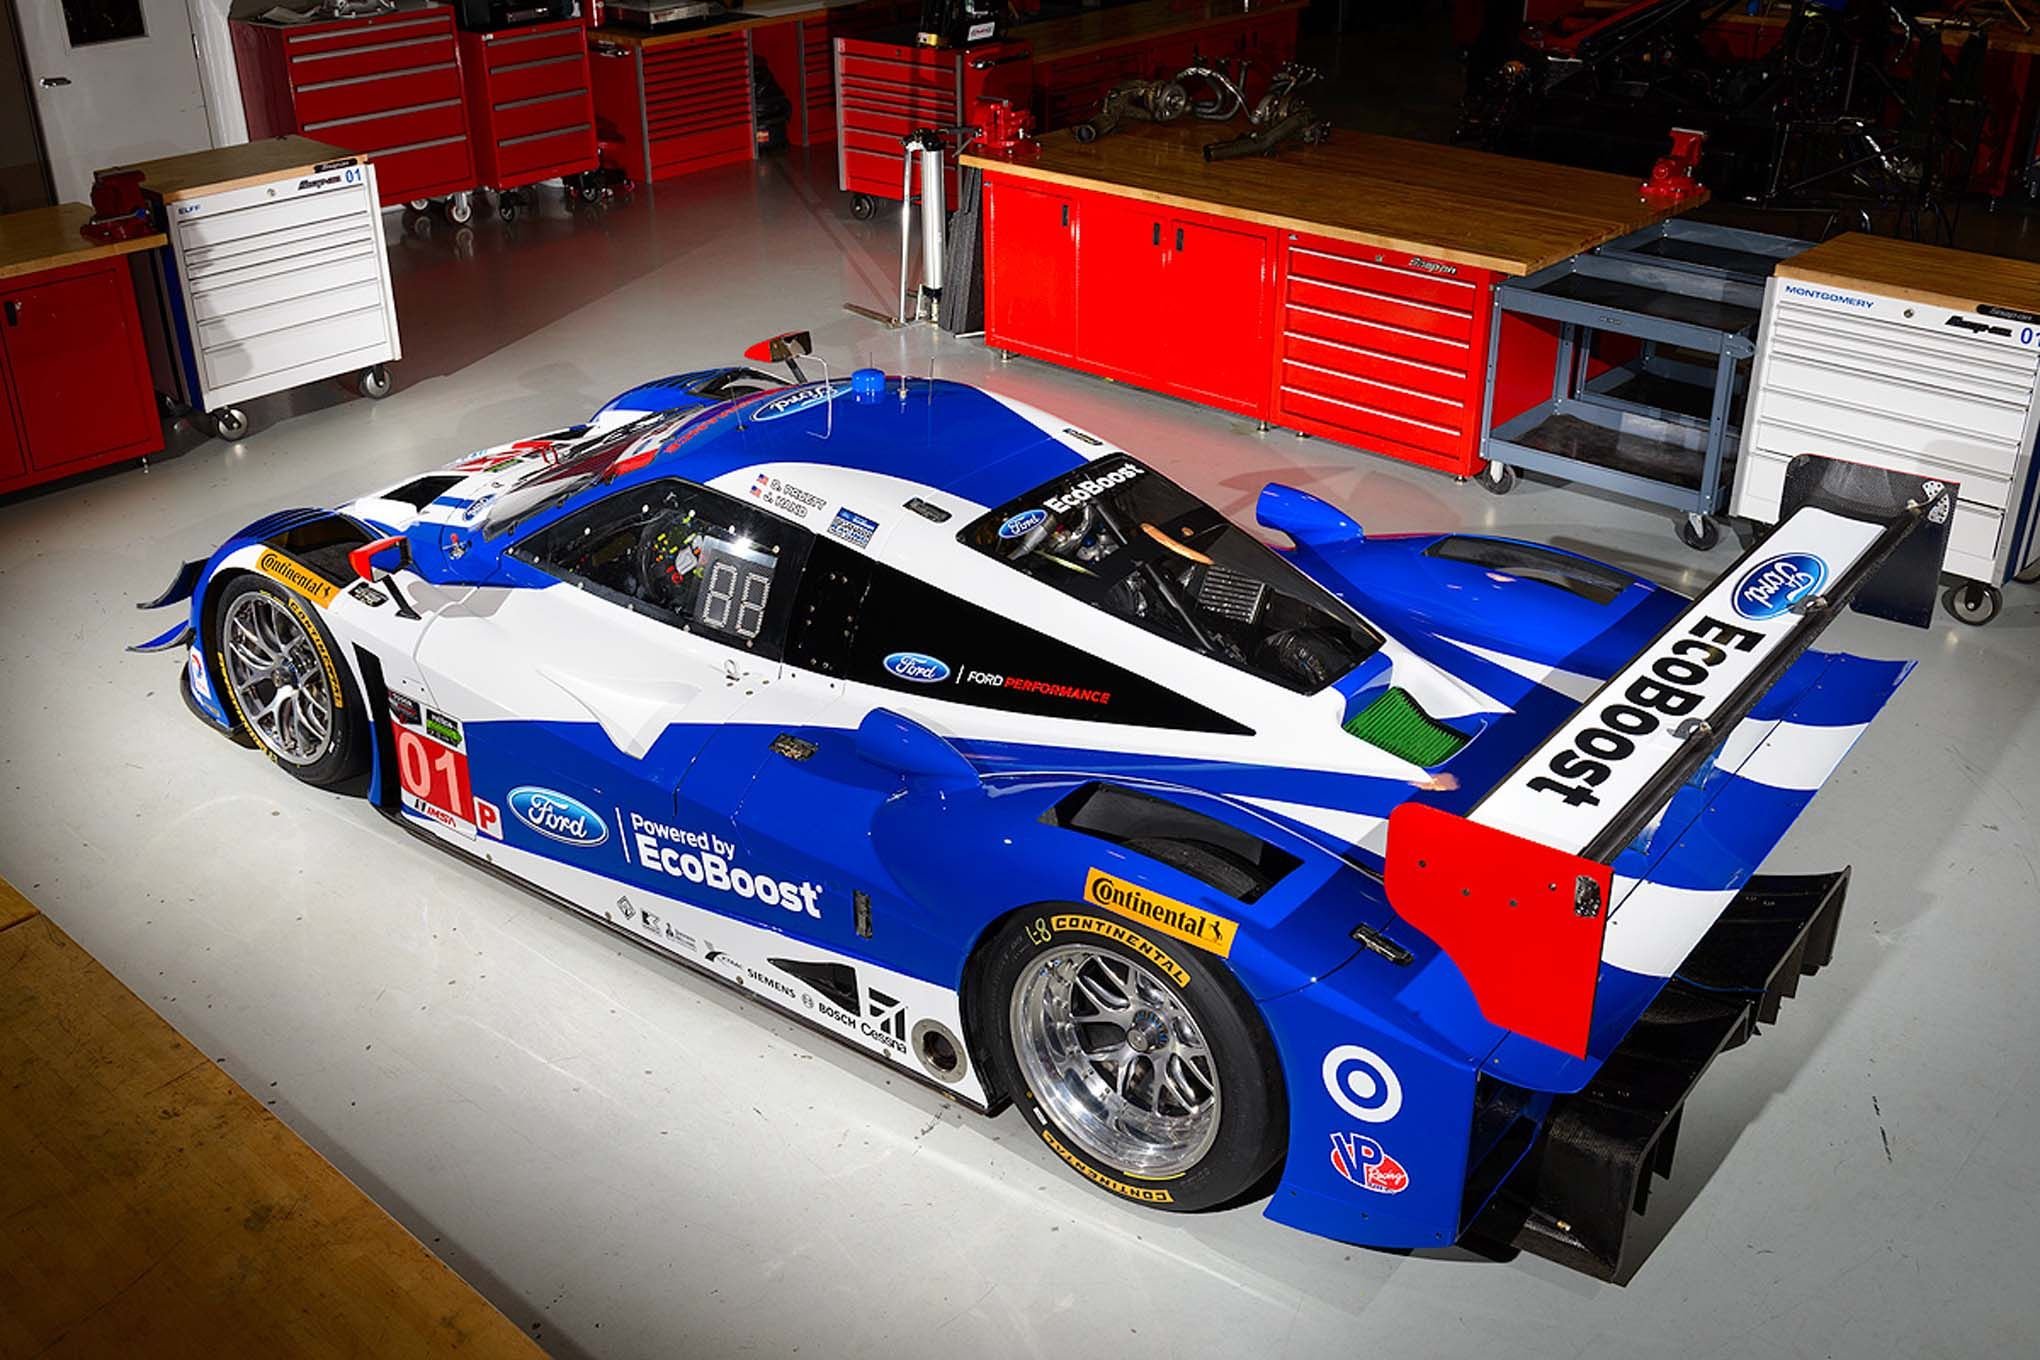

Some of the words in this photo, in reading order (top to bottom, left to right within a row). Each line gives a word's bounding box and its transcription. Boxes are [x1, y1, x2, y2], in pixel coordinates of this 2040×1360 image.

[345, 168, 361, 183] 01
[1785, 285, 1875, 309] MONTGOMERY
[1043, 462, 1146, 514] EcoBoost
[259, 552, 323, 597] Continental
[1743, 560, 1816, 610] Ford
[966, 670, 1004, 688] FORD
[1004, 676, 1111, 705] PERFORMANCE
[1525, 614, 1767, 808] EcoBoost
[398, 730, 463, 816] 01
[478, 800, 497, 830] P
[630, 811, 710, 851] Powered
[712, 834, 735, 861] by
[634, 832, 822, 919] EcoBoost
[1091, 876, 1207, 939] Continental
[1054, 916, 1185, 984] CONTINENTAL
[747, 967, 797, 999] SIEMENS
[818, 1001, 857, 1030] BOSCH
[860, 1021, 908, 1055] Cessna
[1043, 1132, 1168, 1202] CONTINENTAL
[1329, 1131, 1384, 1187] VP
